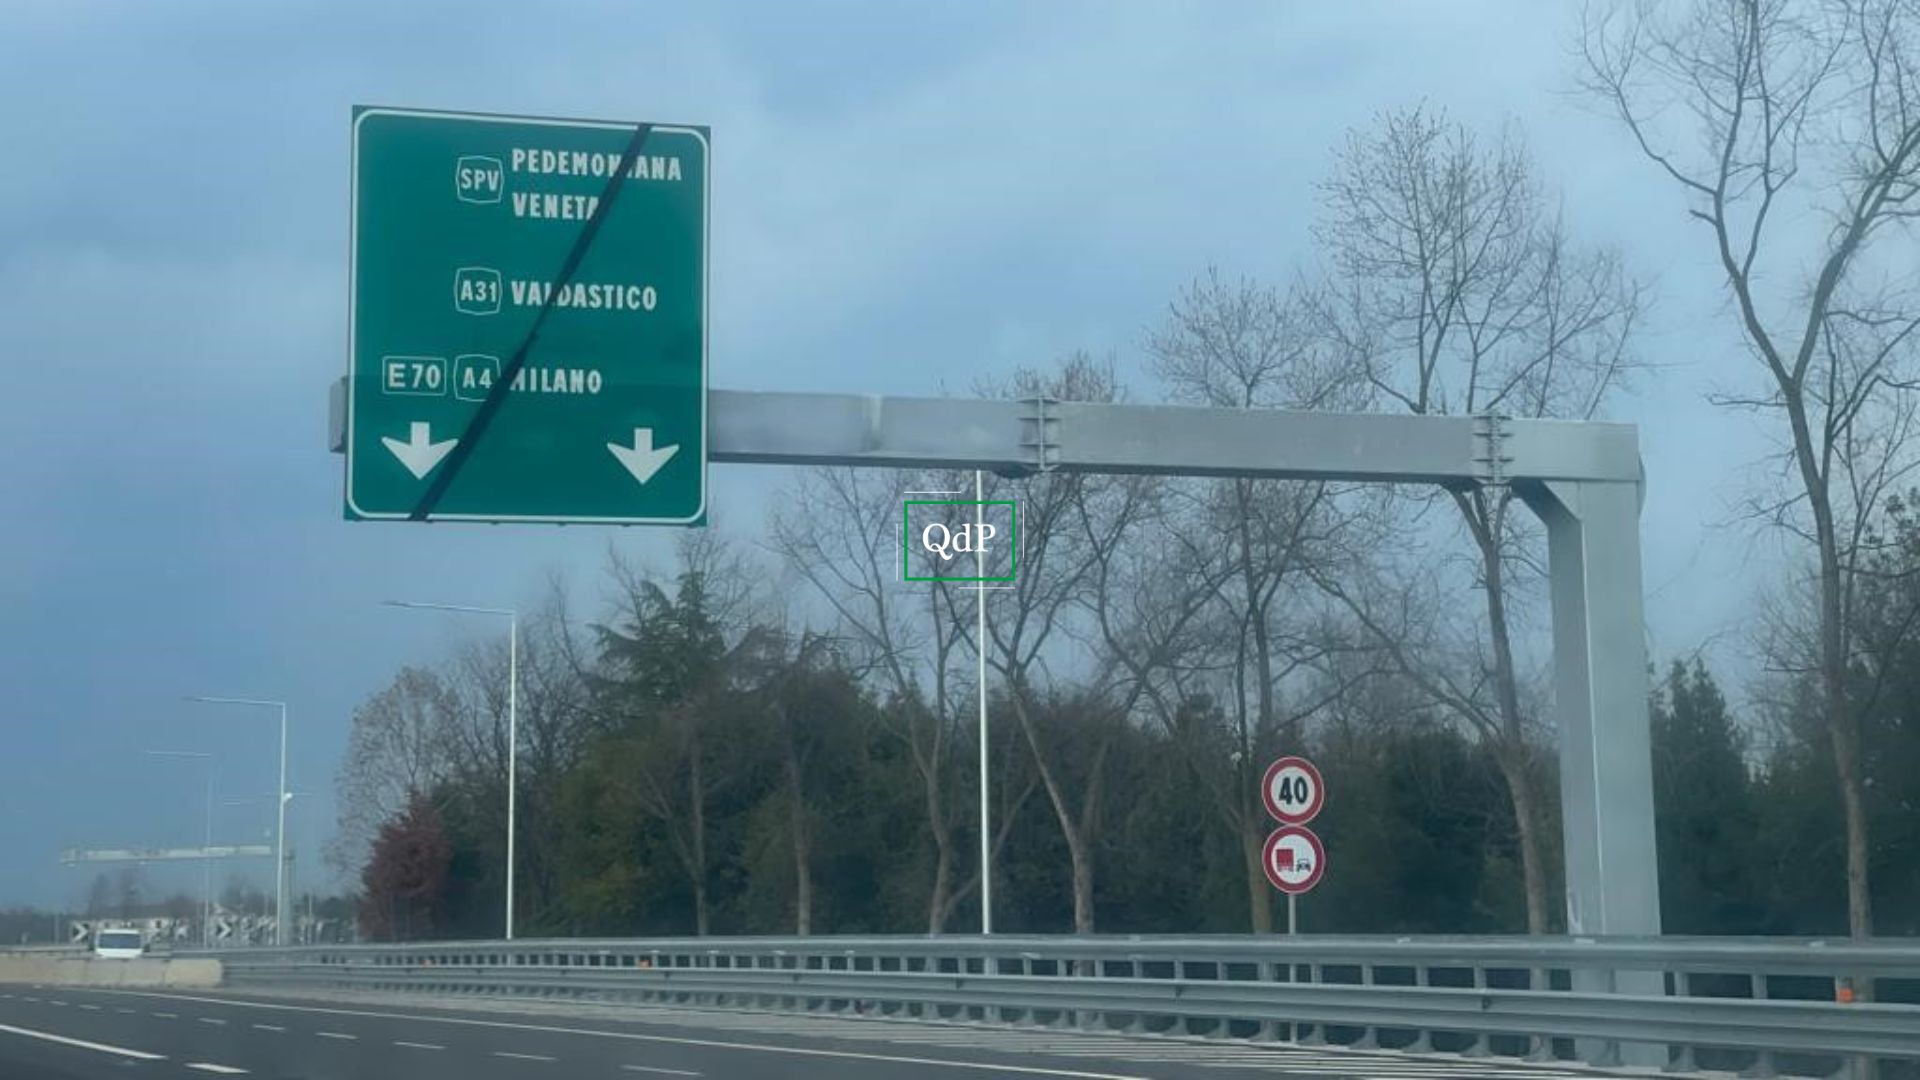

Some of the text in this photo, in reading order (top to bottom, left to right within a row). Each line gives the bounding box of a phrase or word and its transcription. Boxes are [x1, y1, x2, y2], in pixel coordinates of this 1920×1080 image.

[511, 148, 682, 181] PEDEMONANA
[460, 168, 499, 192] SPV
[460, 280, 497, 302] A31
[388, 363, 441, 389] E 70
[463, 368, 492, 389] A4
[1279, 776, 1308, 805] 40
